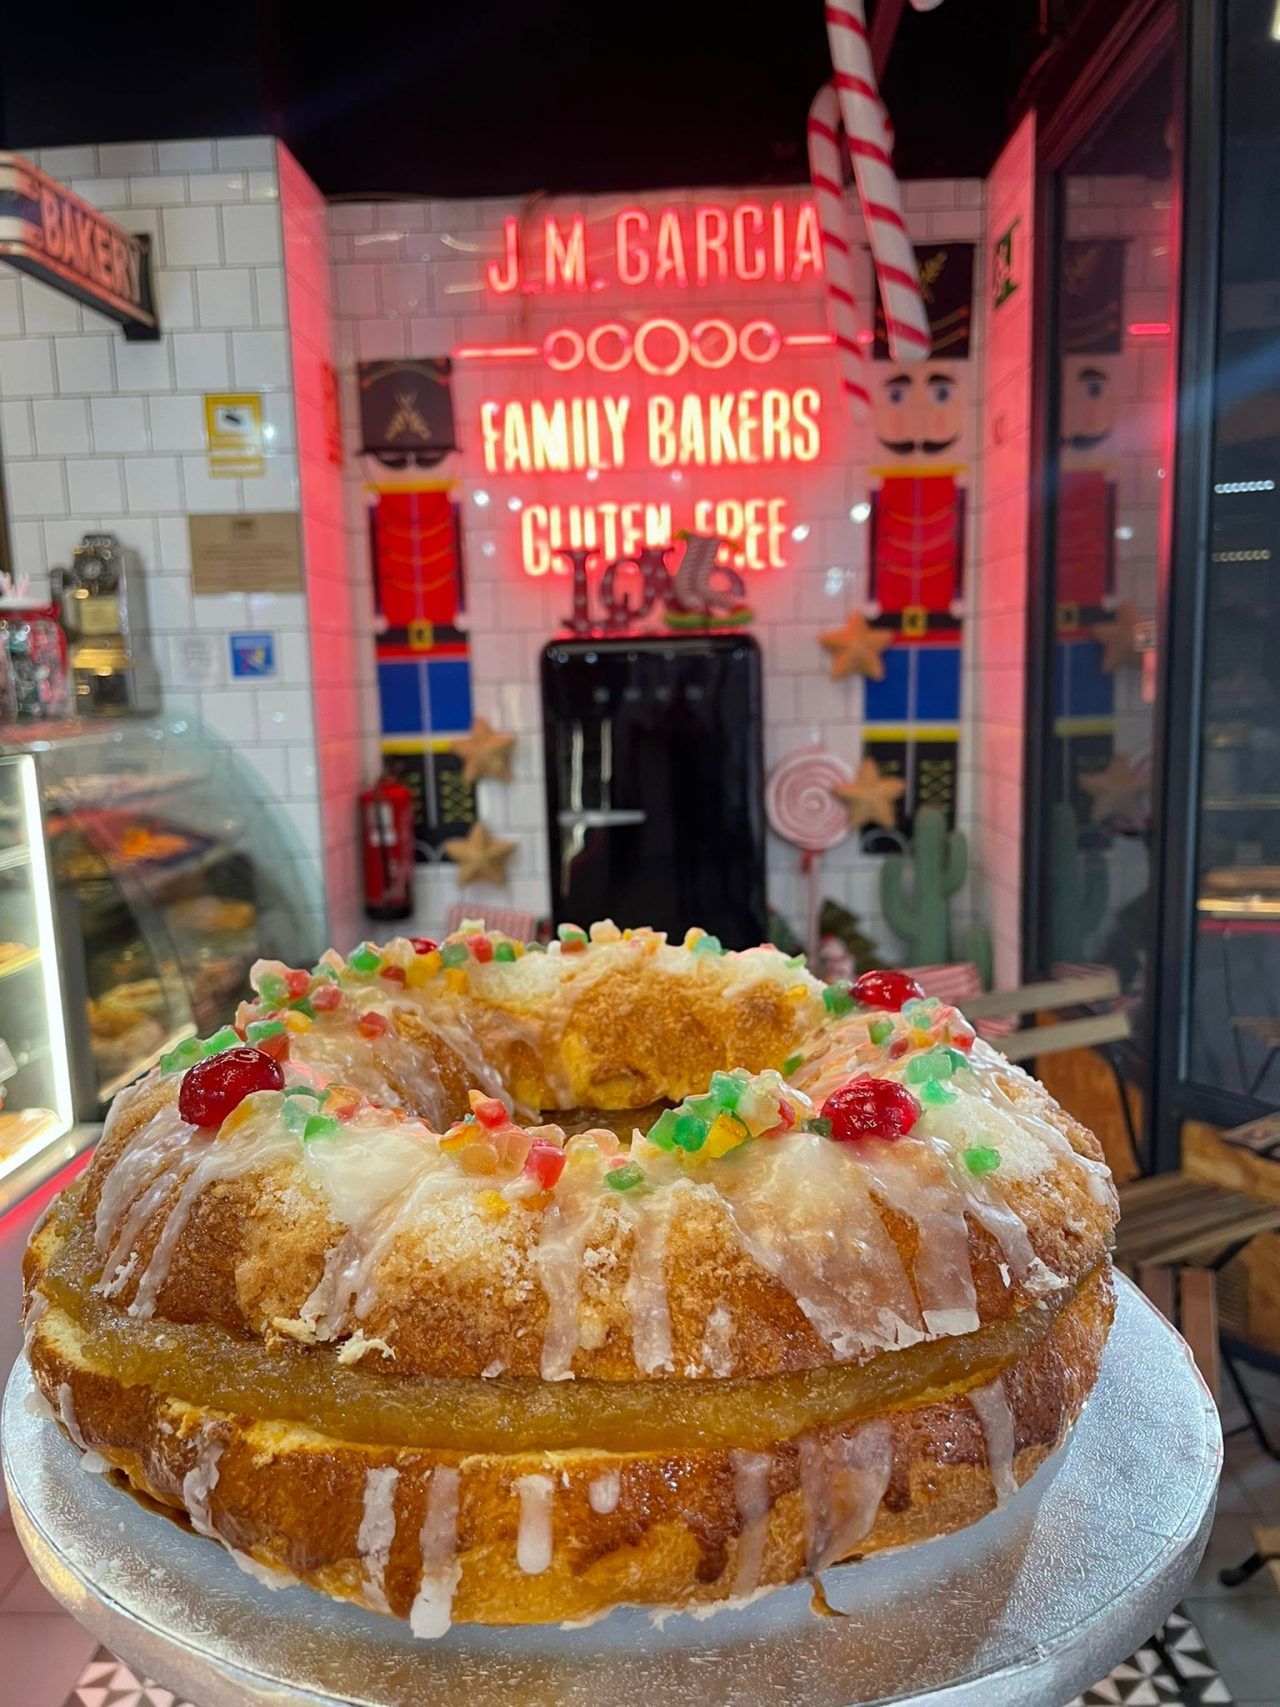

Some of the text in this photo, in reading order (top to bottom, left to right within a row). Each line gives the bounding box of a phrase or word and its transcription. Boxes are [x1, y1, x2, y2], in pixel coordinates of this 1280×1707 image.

[39, 187, 142, 306] BAKERY
[615, 200, 825, 288] GARCIA
[480, 386, 822, 474] FAMILY BAKERS
[521, 497, 789, 577] GLUTEN FREE
